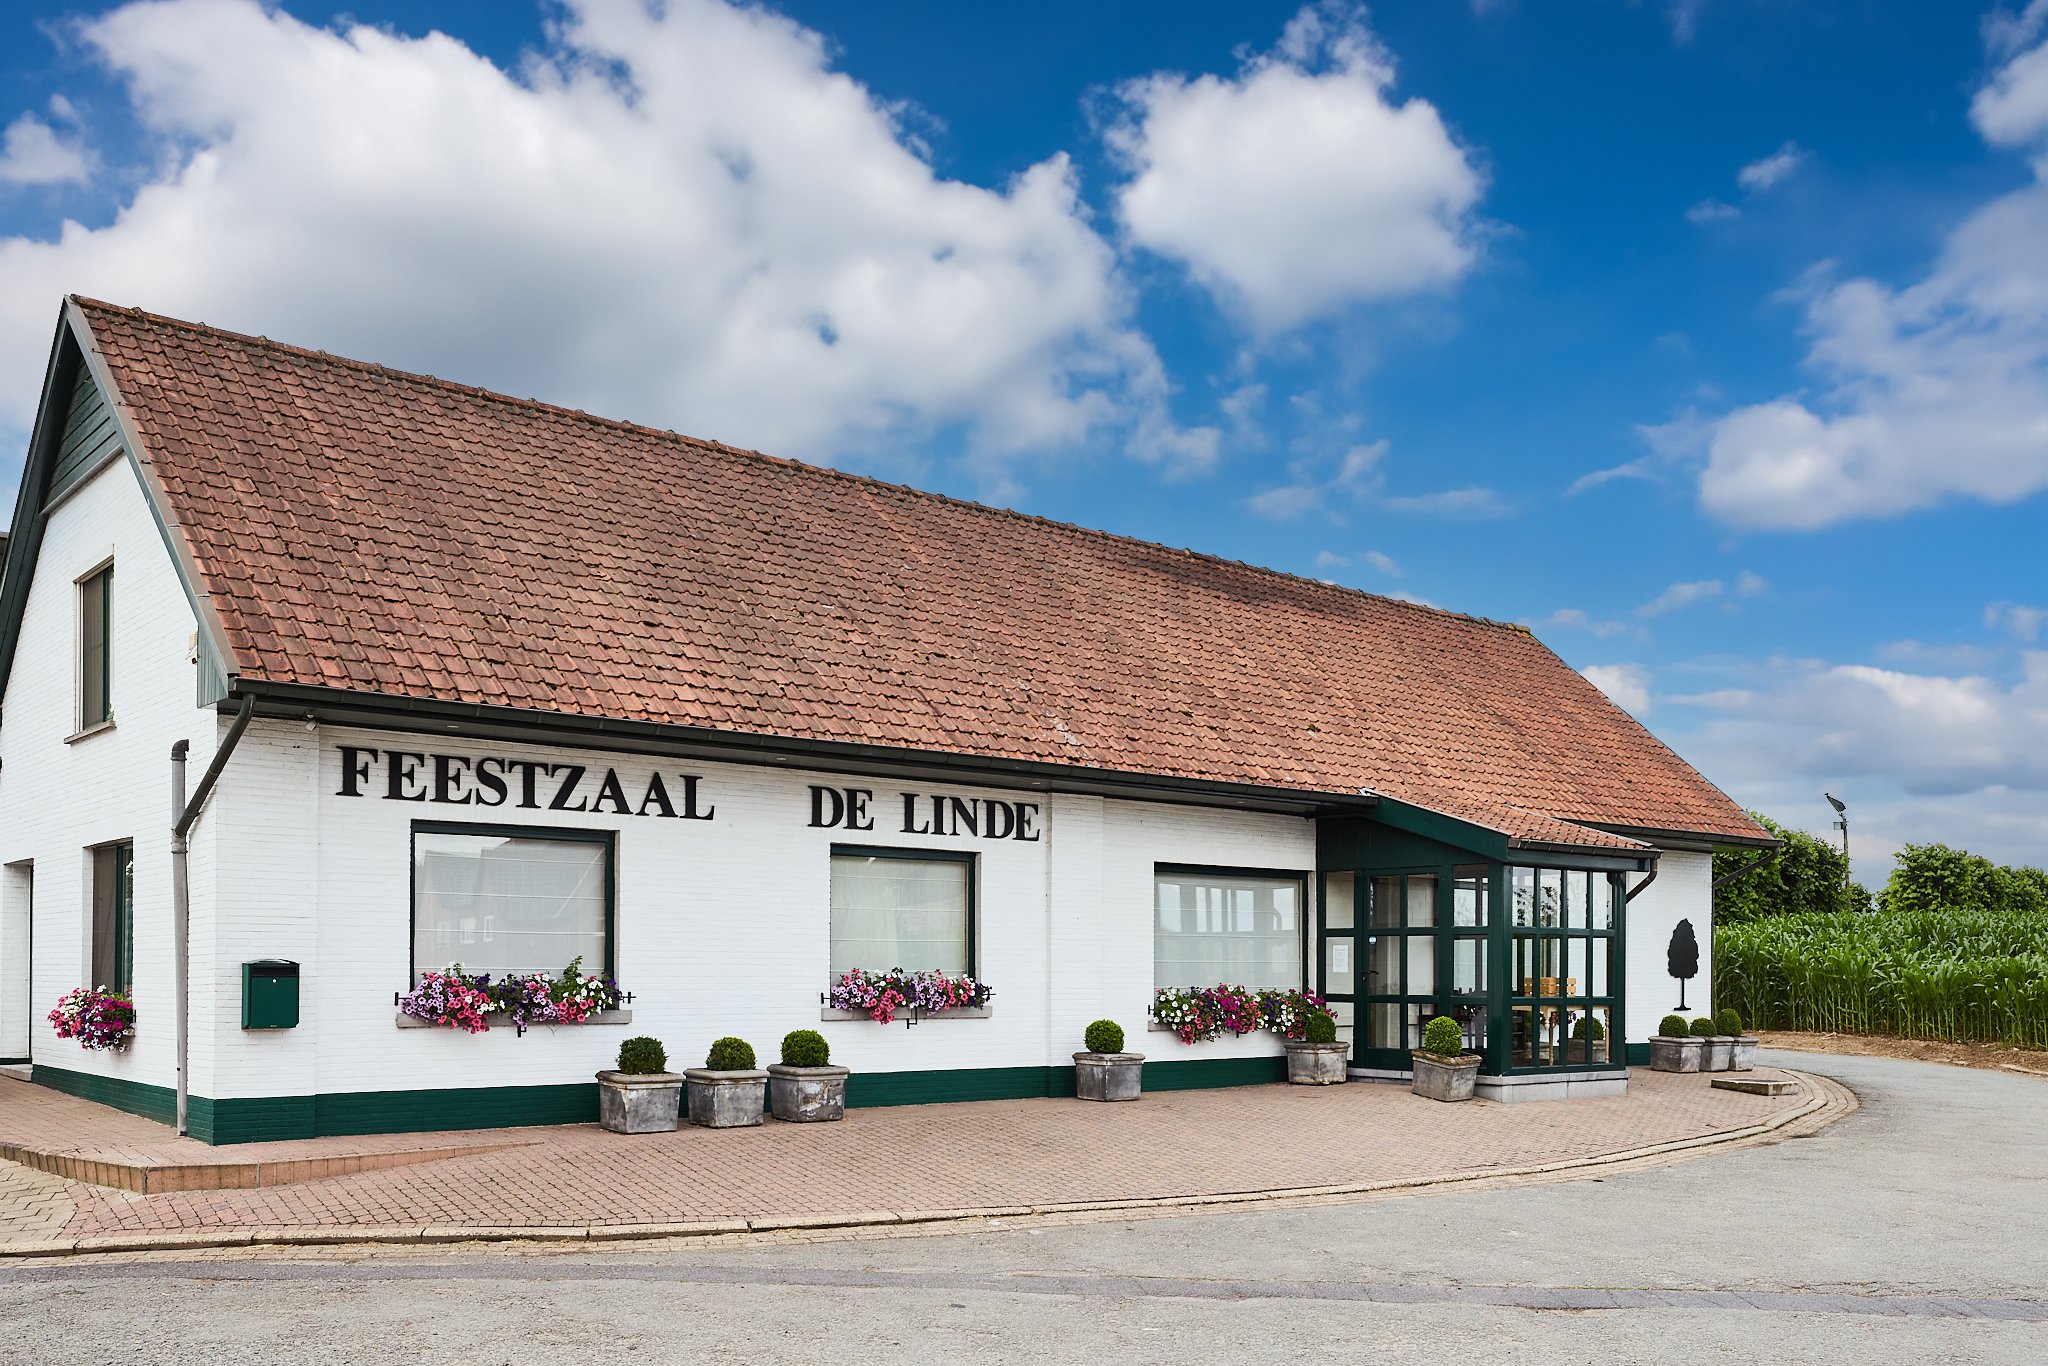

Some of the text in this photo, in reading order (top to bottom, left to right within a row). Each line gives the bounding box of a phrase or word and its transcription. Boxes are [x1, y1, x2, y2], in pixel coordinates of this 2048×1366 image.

[335, 745, 1040, 841] FEESTZAAL DE LINDE
